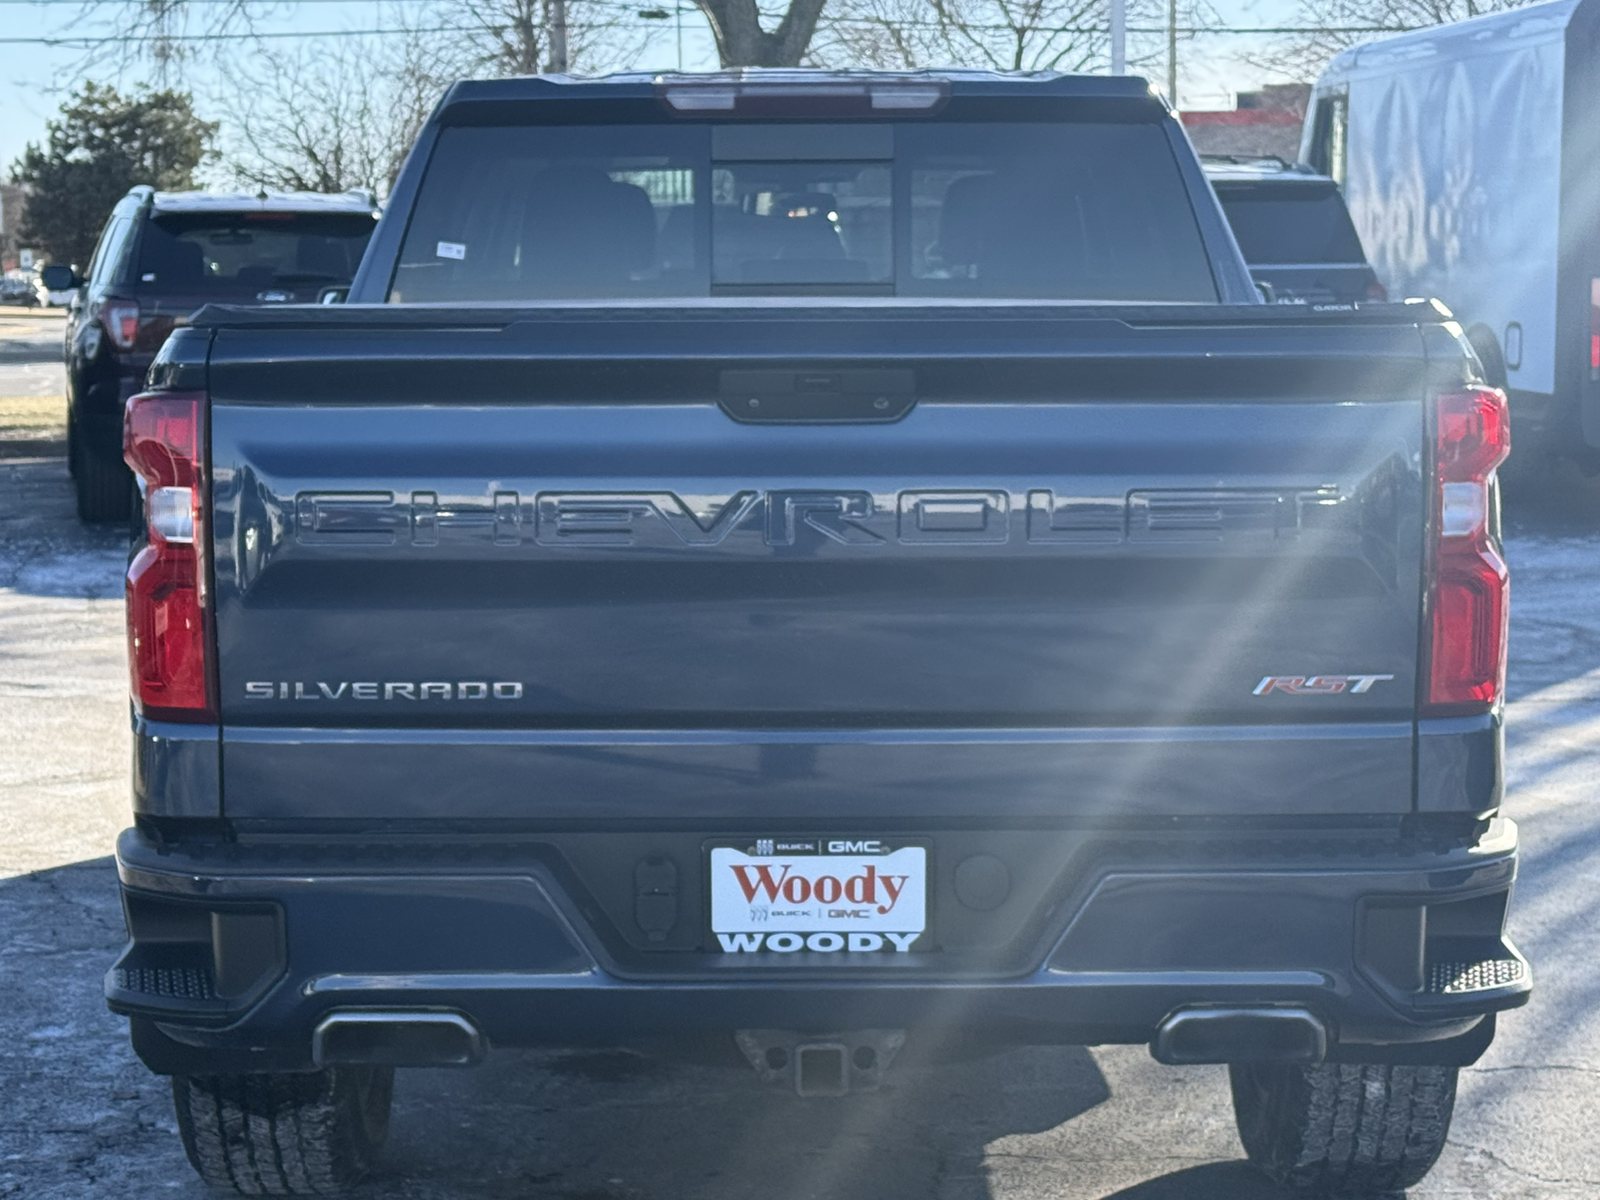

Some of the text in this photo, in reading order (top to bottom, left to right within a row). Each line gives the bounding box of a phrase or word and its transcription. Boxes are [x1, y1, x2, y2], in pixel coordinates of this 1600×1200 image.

[294, 487, 1341, 546] CHEVROLET
[245, 681, 524, 700] SILVERADO
[1252, 674, 1394, 695] RST
[827, 840, 881, 853] GMC
[728, 864, 910, 915] Woody
[827, 909, 871, 919] GMC
[716, 932, 922, 953] WOODY
